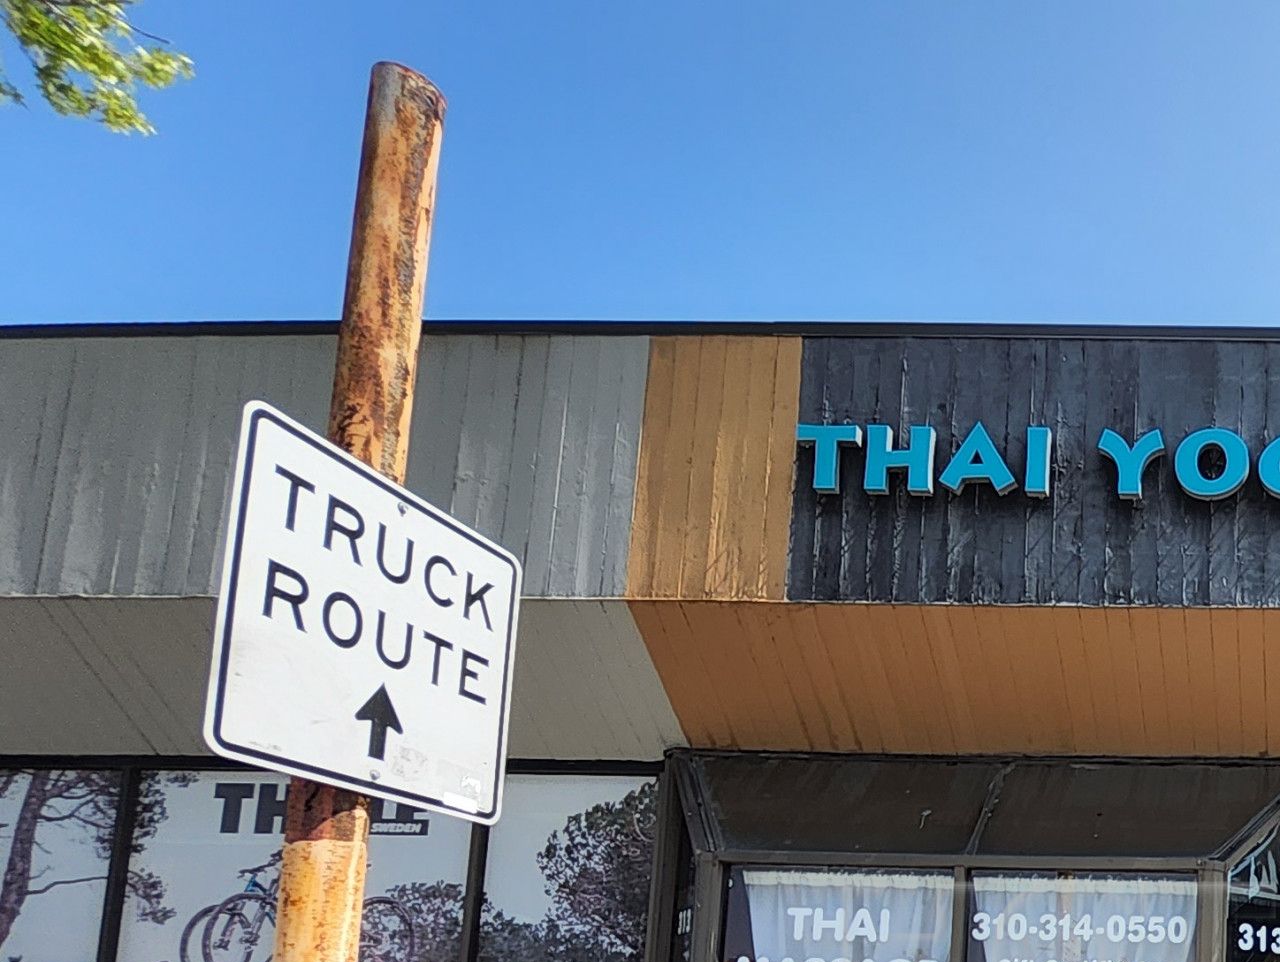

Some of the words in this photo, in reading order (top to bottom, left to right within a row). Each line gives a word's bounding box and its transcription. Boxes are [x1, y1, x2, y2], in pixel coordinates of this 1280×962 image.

[796, 421, 1051, 497] THAI
[275, 464, 494, 631] TRUCK
[262, 559, 490, 705] ROUTE
[370, 822, 422, 833] SWEDEN
[787, 907, 890, 943] THAI
[971, 912, 1187, 943] 310-314-0550
